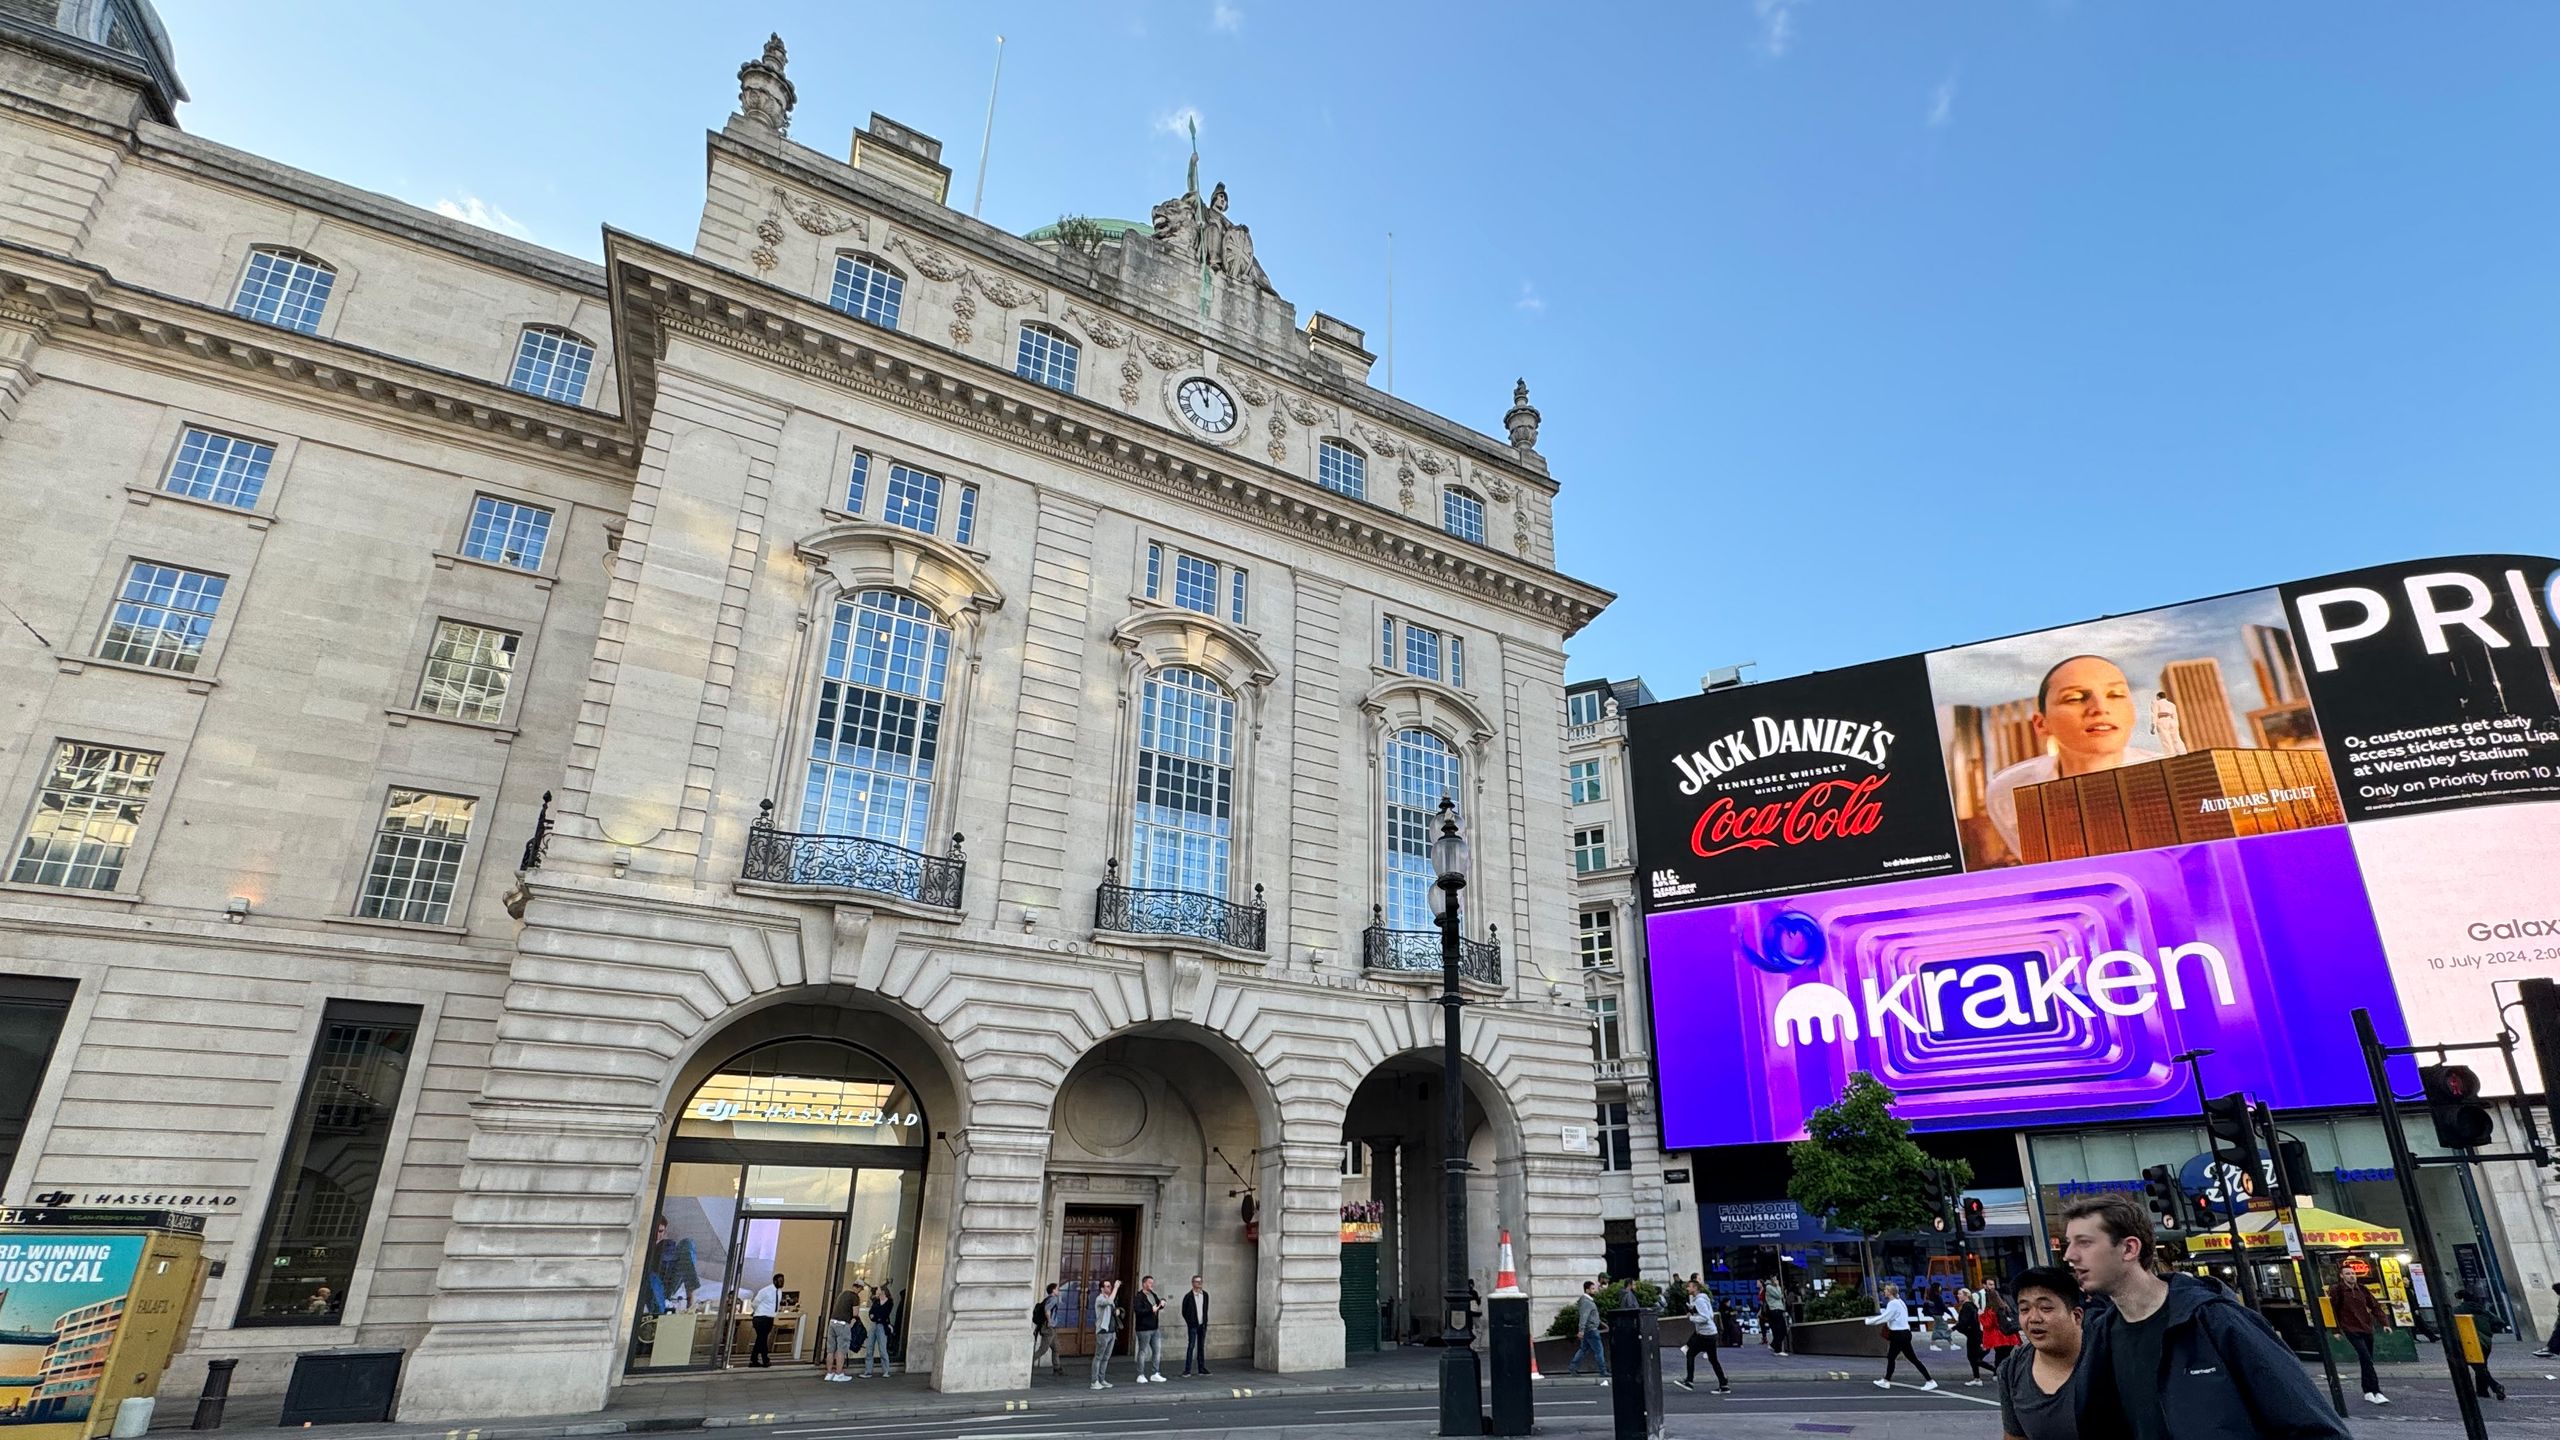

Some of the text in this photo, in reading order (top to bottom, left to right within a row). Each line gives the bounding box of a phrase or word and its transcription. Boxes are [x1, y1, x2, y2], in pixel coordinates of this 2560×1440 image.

[2296, 567, 2560, 673] PRI
[2369, 723, 2459, 745] customers
[2461, 719, 2491, 735] get
[2493, 716, 2532, 730] early
[1671, 716, 1895, 795] JACK DANIEL'S
[2349, 729, 2559, 763] access tickets to Dua Lipa
[2353, 747, 2529, 777] at Wembley Stadium
[1717, 763, 1847, 791] TENNESSEE WHISKEY
[1754, 781, 1810, 795] MIXED WITH
[2359, 783, 2399, 799] Only
[2402, 780, 2425, 792] on
[2428, 772, 2488, 789] Priority
[2490, 769, 2530, 782] from
[2531, 766, 2551, 778] 10
[2200, 785, 2317, 813] AUDEMARS PIGUET
[1690, 771, 1891, 858] Coca-Cola
[1652, 869, 1680, 881] ALC.
[2467, 918, 2560, 941] Galax
[1048, 938, 1149, 962] COUNTY
[1215, 960, 1264, 976] FIRE
[2428, 958, 2445, 969] 10
[2449, 954, 2481, 969] July
[1862, 942, 2236, 1038] kraken
[763, 1105, 919, 1127] HASSELBLAD
[2335, 1166, 2395, 1183] beau
[95, 1194, 237, 1206] HASSELBLAD
[1719, 1202, 1797, 1215] FAN ZONE
[1065, 1215, 1085, 1224] GYM
[1100, 1216, 1114, 1224] SPA
[1720, 1212, 1798, 1222] WILLIAMS RACING
[1720, 1220, 1800, 1233] FAN ZONE
[2204, 1238, 2220, 1248] HOT
[2246, 1233, 2270, 1245] SPOT
[2328, 1231, 2360, 1242] DOG
[2362, 1231, 2398, 1242] SPOT
